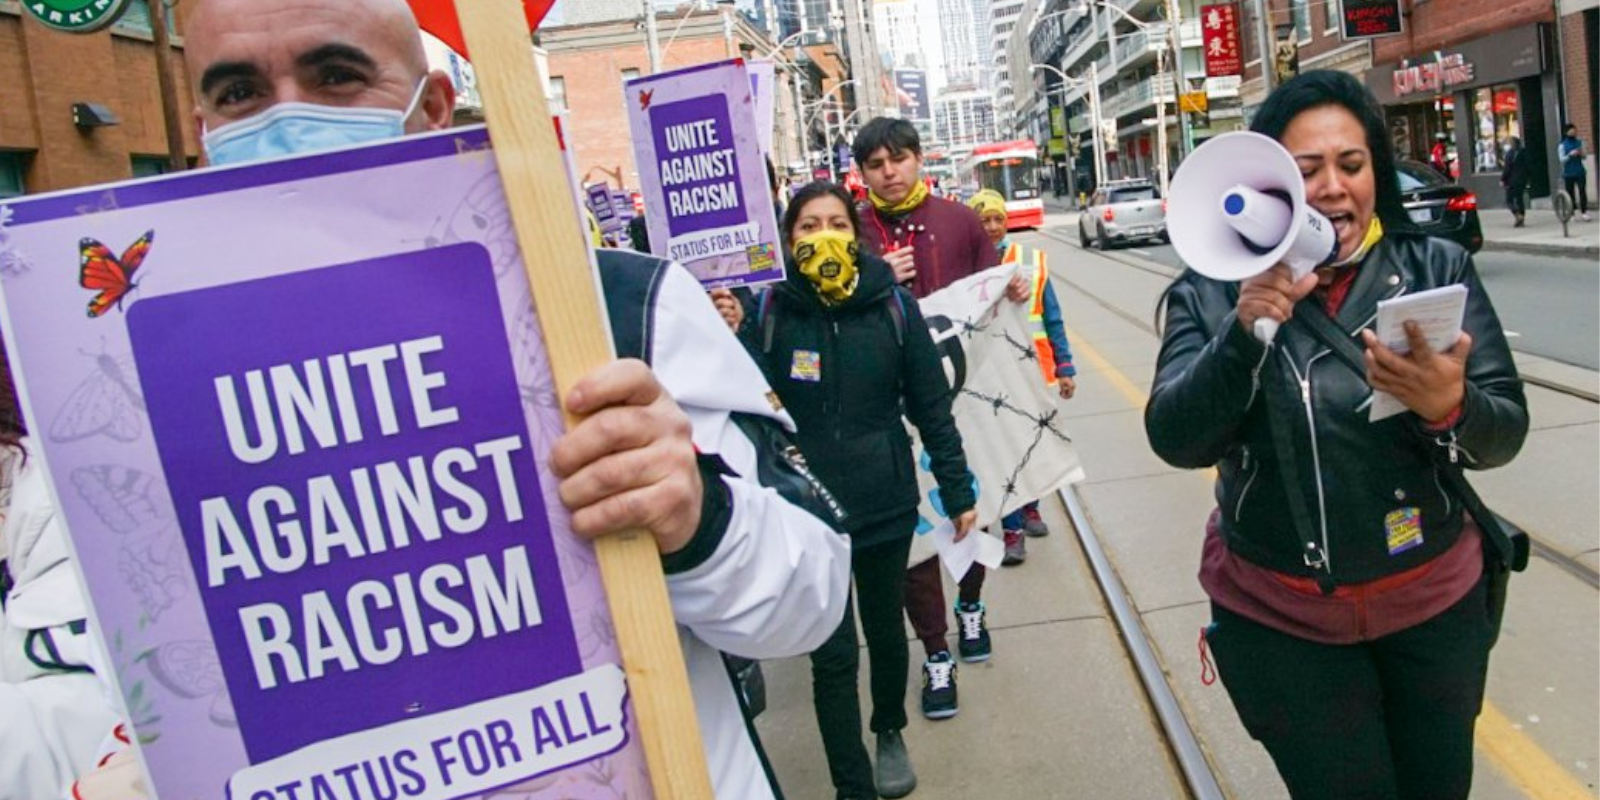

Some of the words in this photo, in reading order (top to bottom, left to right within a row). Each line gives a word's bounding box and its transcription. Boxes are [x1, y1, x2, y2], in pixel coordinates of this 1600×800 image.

[661, 149, 734, 187] AGAINST
[665, 118, 719, 152] UNITE
[669, 181, 739, 217] RACISM
[670, 240, 709, 260] STATUS
[711, 233, 733, 251] FOR
[735, 229, 755, 246] ALL
[214, 335, 460, 464] UNITE
[200, 435, 524, 588] AGAINST
[238, 545, 543, 690] RACISM
[430, 718, 522, 787] FOR
[530, 691, 612, 755] ALL
